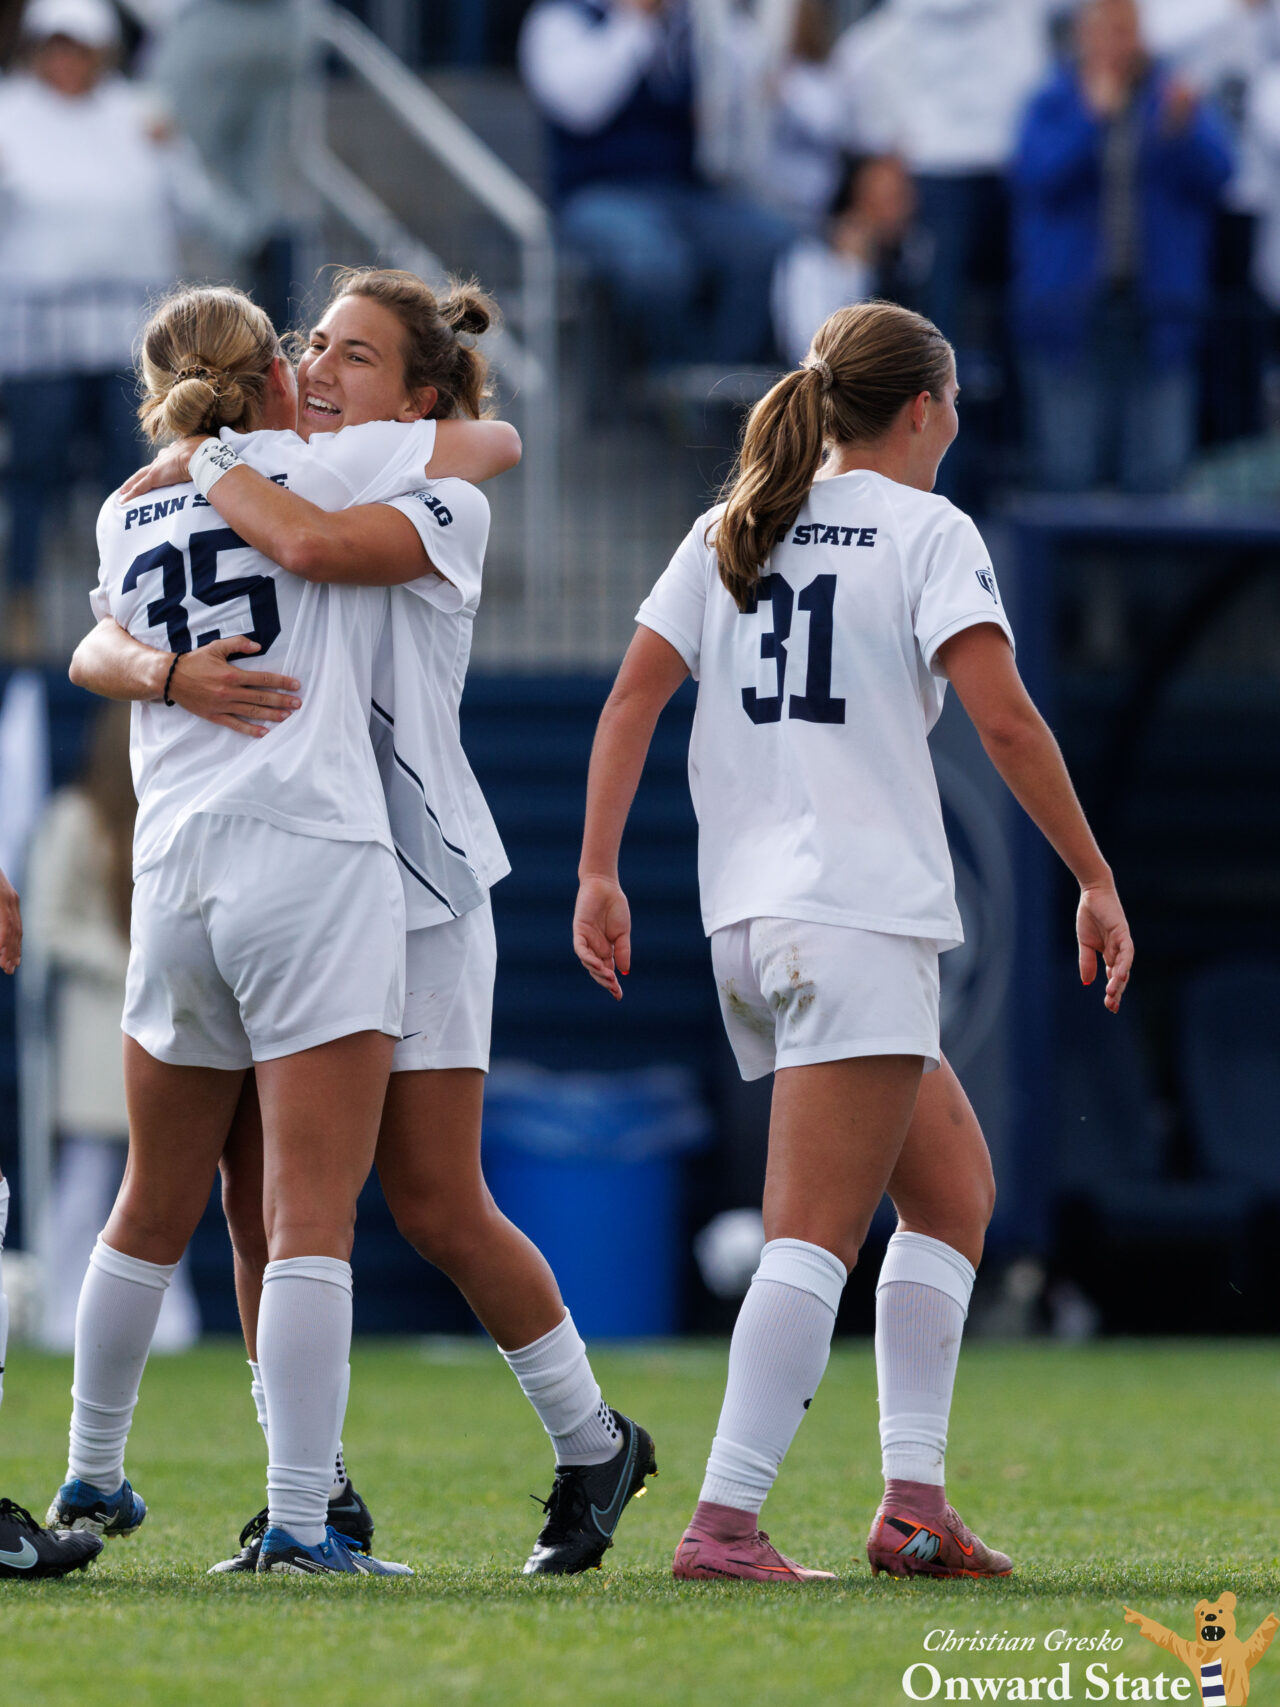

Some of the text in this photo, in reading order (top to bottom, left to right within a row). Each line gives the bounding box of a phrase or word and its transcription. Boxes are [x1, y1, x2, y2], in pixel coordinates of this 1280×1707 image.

[124, 495, 188, 531] PENN
[792, 523, 878, 548] STATE
[121, 527, 282, 662] 35
[738, 572, 846, 725] 31
